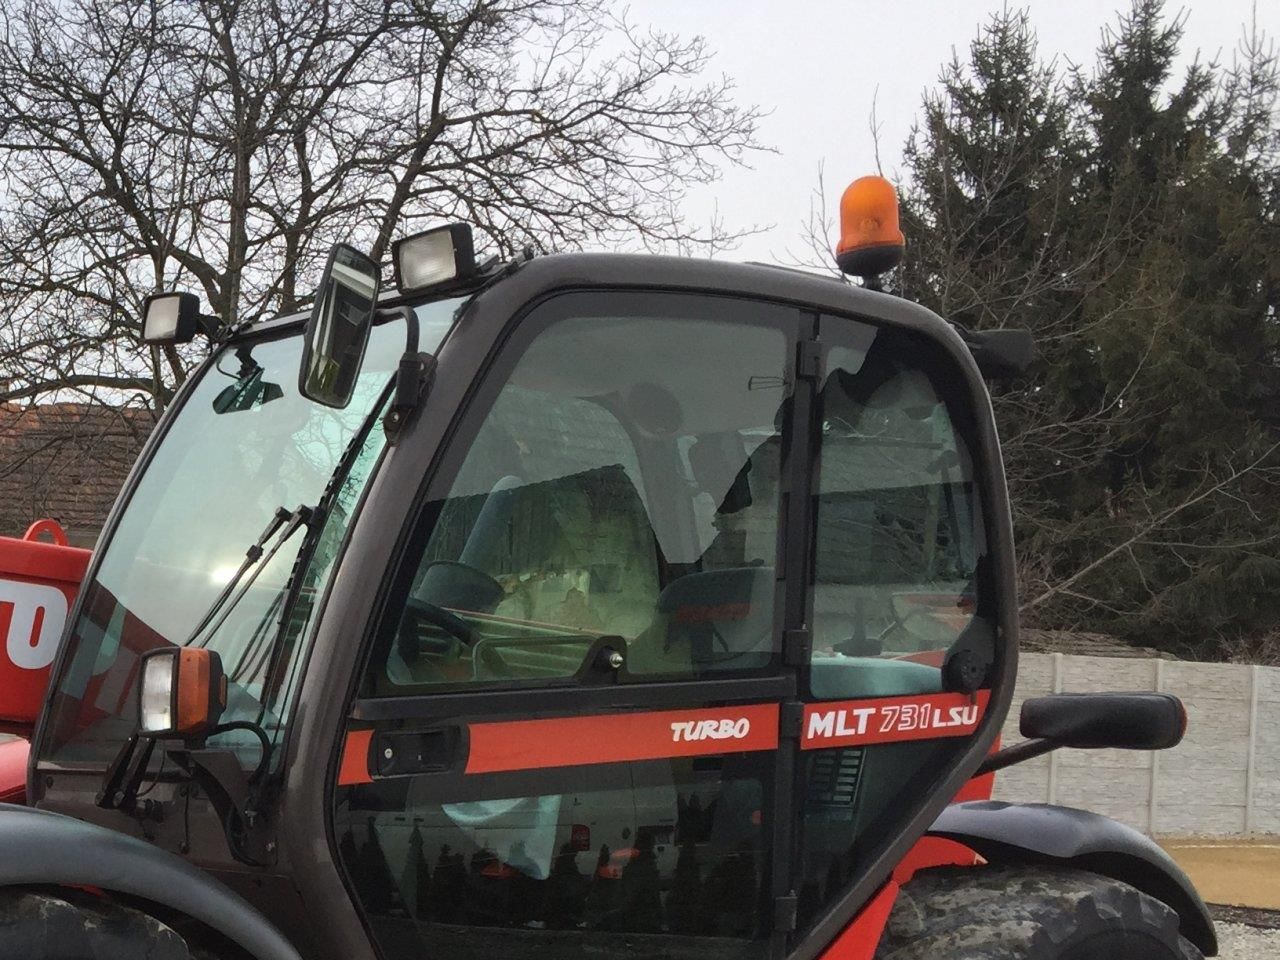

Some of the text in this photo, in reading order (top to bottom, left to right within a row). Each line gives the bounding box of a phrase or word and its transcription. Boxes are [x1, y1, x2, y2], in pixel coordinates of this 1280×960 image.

[671, 718, 750, 742] TURBO
[807, 703, 977, 739] MLT 731 LSU
